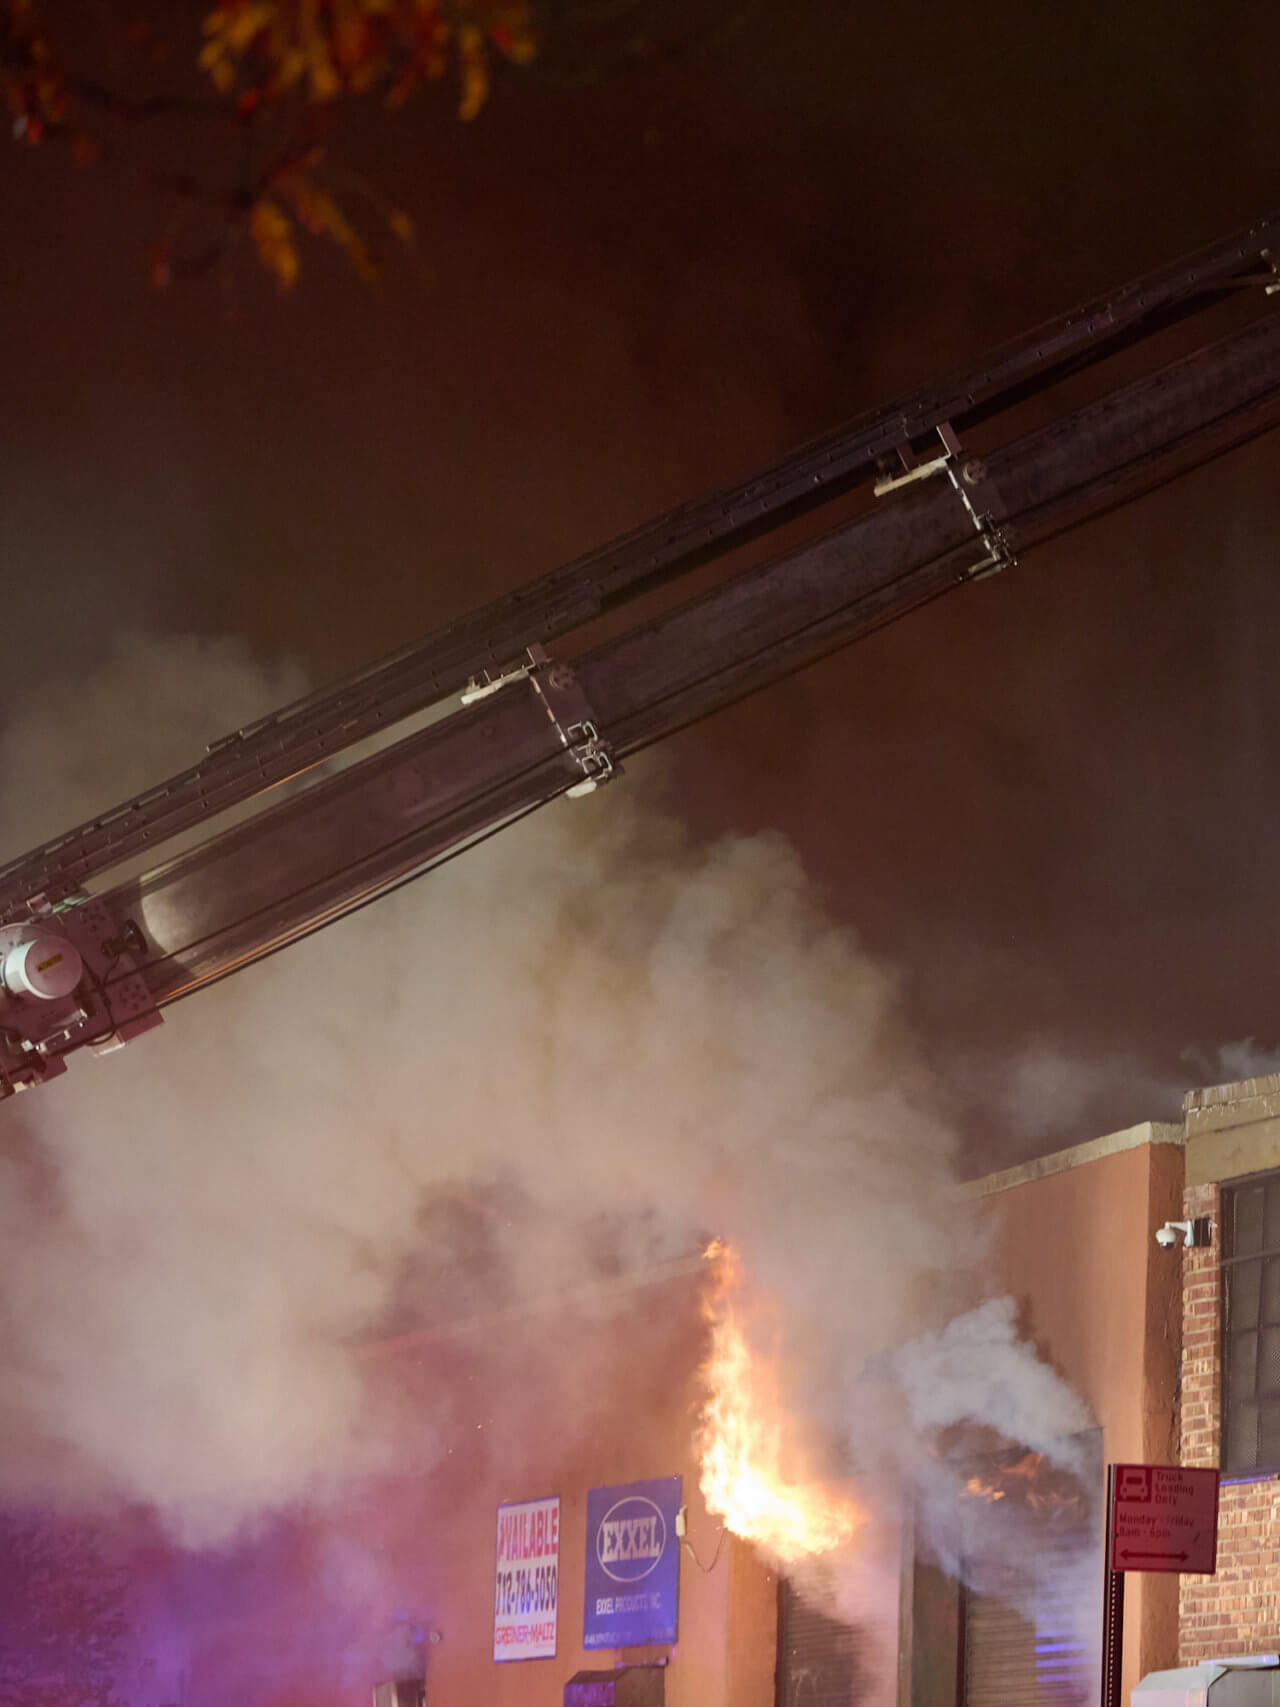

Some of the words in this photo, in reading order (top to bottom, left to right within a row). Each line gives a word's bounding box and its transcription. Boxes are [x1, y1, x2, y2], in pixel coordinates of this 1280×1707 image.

[1156, 1471, 1183, 1482] Truck
[1155, 1483, 1194, 1497] Loading
[1155, 1495, 1177, 1506] Only
[1119, 1513, 1156, 1528] Monday
[1167, 1514, 1194, 1528] Friday
[496, 1508, 558, 1560] AVAILABLE
[602, 1516, 660, 1562] EXXEL
[596, 1598, 614, 1615] EXXEL
